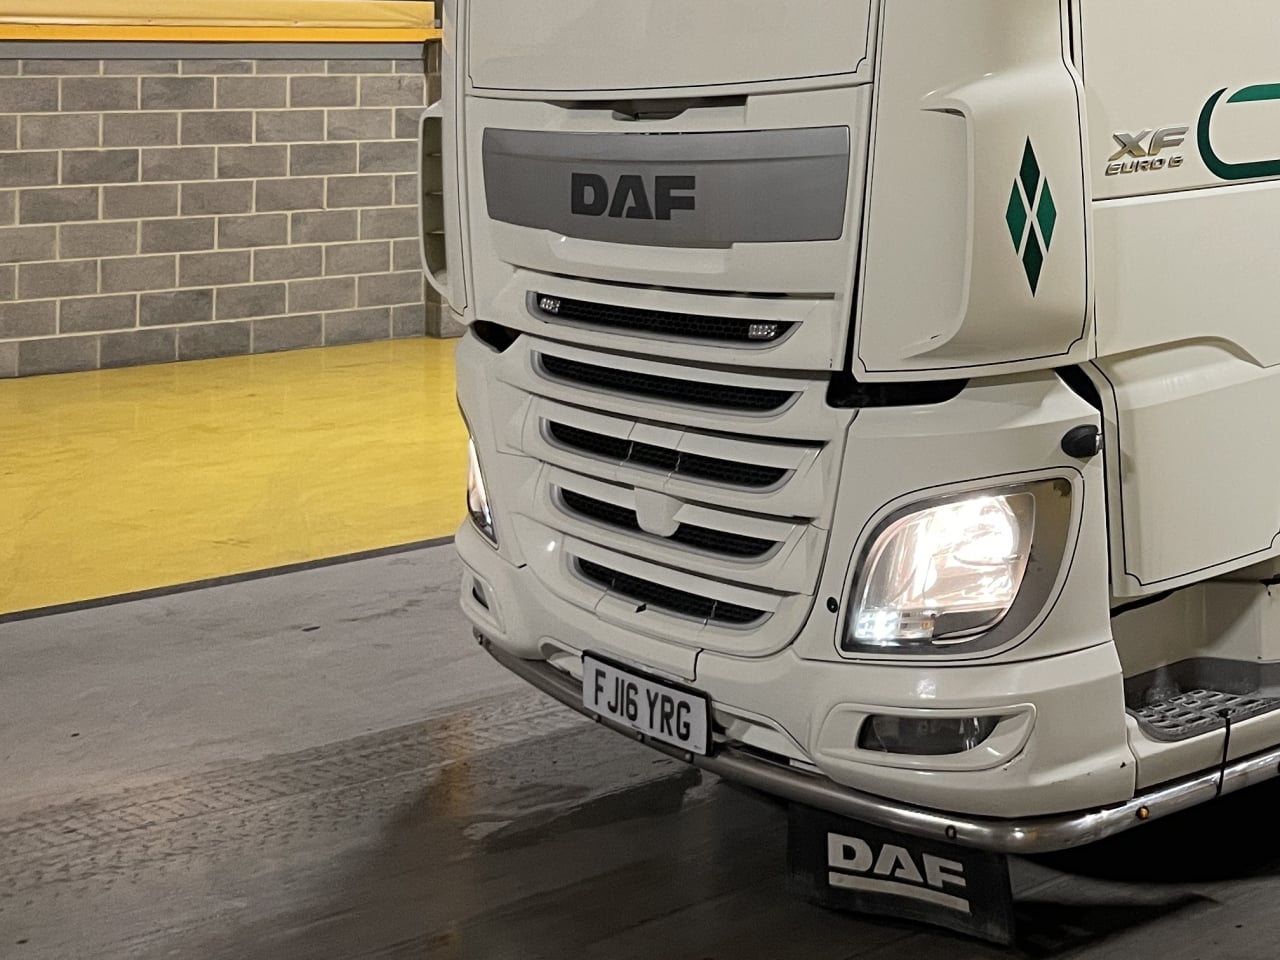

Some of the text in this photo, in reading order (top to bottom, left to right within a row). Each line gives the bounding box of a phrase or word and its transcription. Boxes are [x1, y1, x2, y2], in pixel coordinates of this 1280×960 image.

[1104, 156, 1184, 177] EURO 6
[1108, 126, 1190, 162] XF
[571, 172, 696, 221] DAF
[595, 668, 691, 742] FJ16 YRG
[827, 831, 967, 889] DAF
